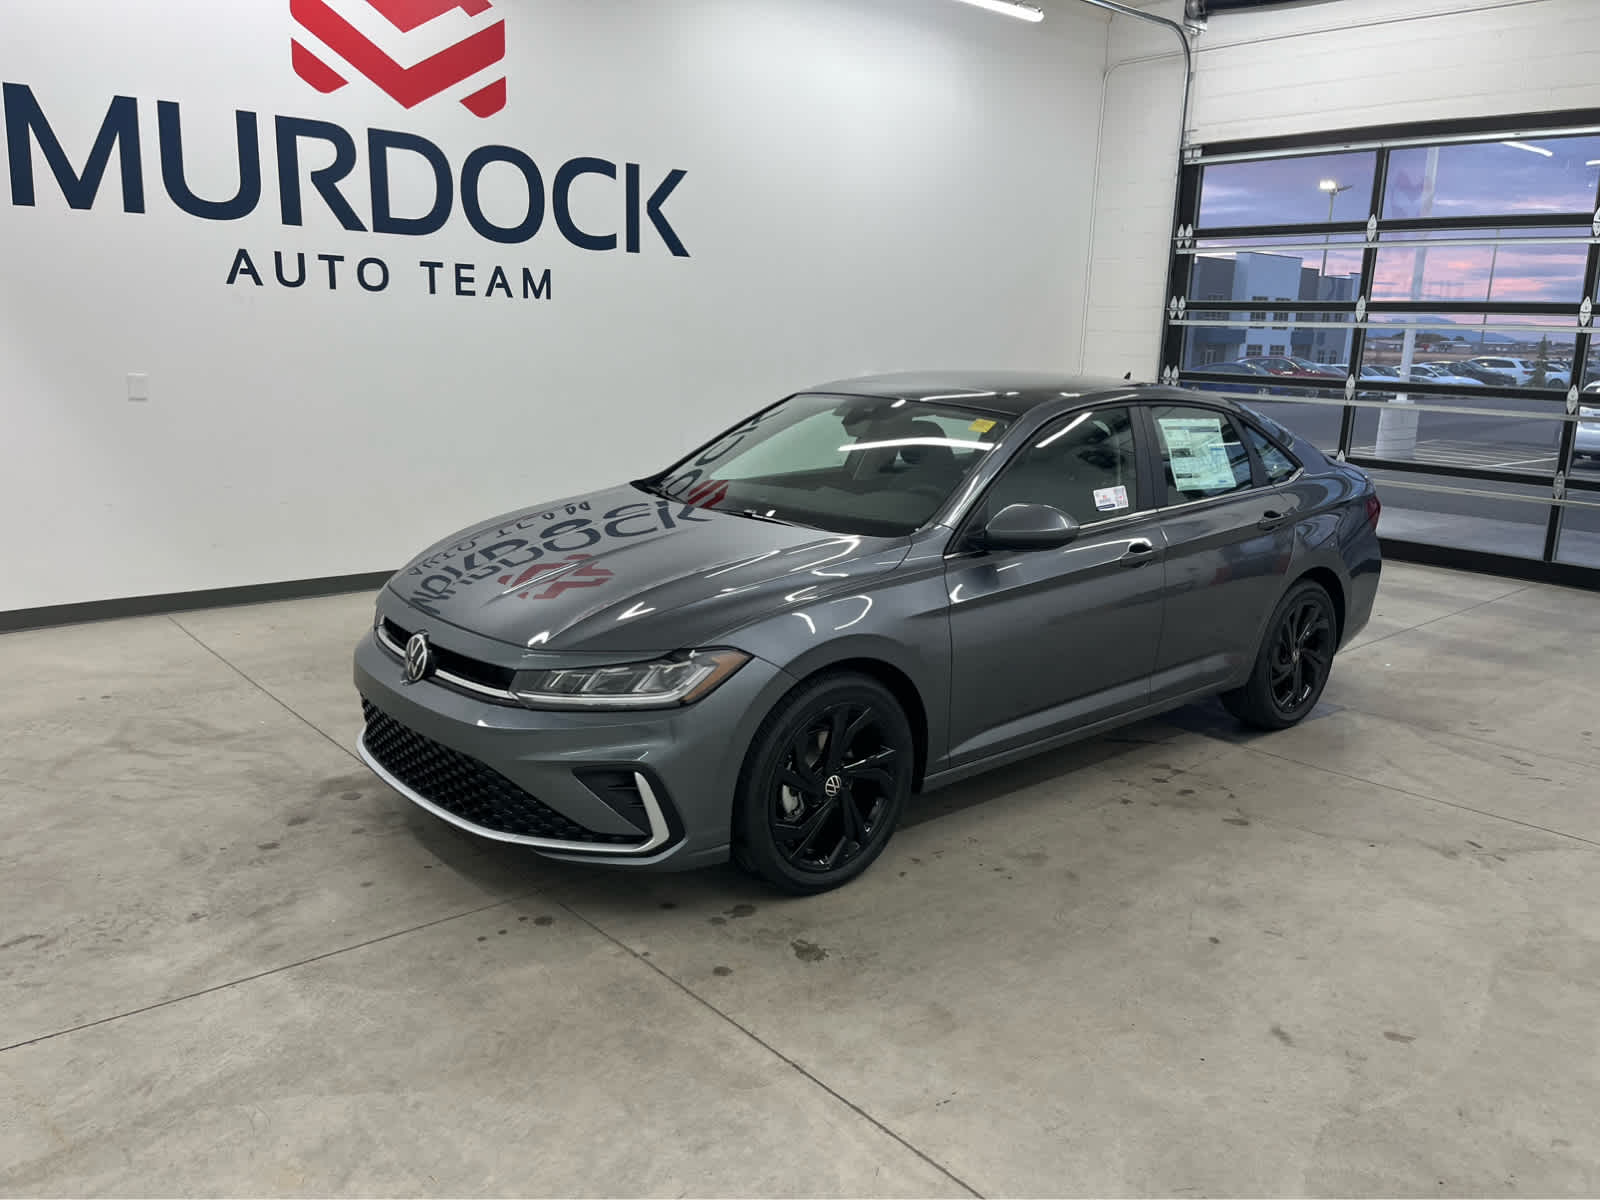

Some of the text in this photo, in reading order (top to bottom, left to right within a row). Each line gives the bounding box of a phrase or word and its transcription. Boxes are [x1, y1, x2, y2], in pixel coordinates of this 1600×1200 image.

[3, 82, 691, 258] MURDOCK
[226, 248, 552, 300] AUTO TEAM
